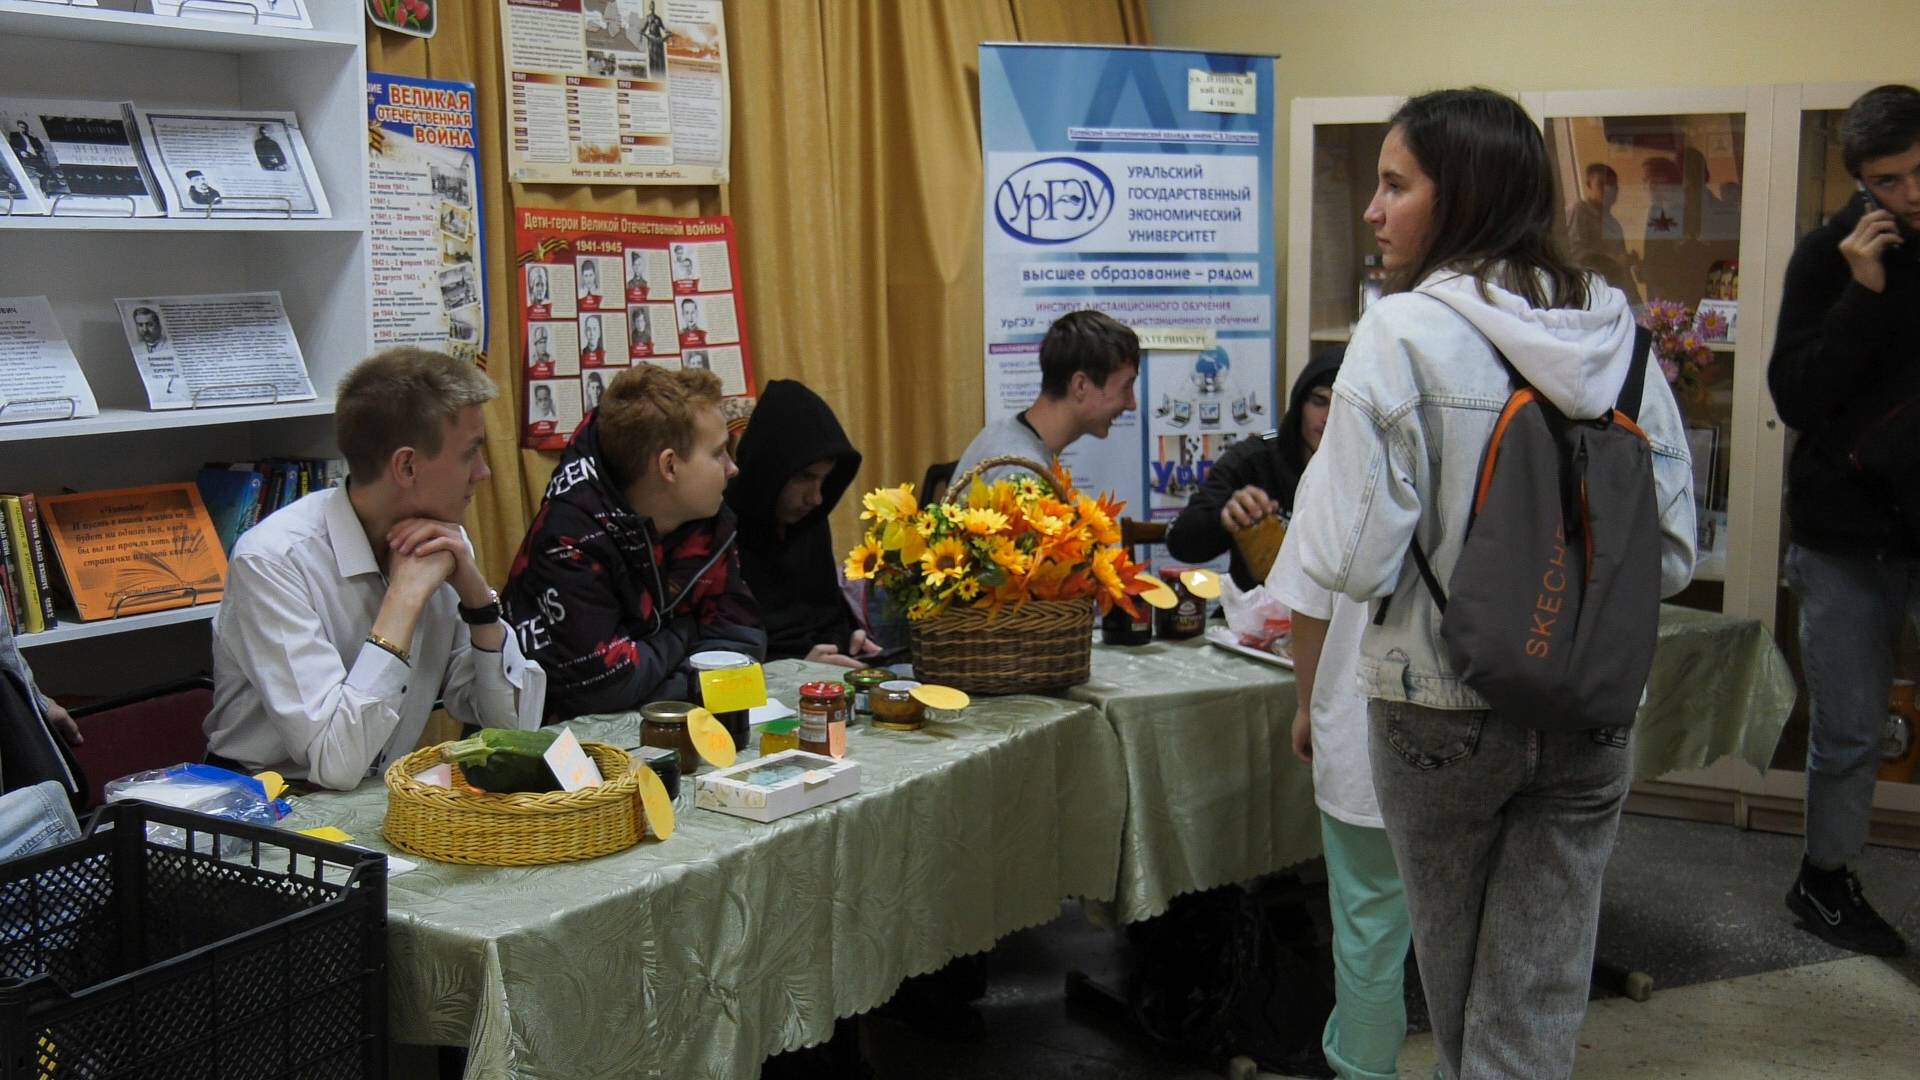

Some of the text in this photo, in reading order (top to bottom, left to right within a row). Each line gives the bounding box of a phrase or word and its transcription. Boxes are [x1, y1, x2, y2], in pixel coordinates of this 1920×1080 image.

[389, 84, 471, 111] ВЕЛИКАЯ
[376, 105, 472, 128] ОТЕЧЕСТВЕННАЯ
[414, 126, 474, 147] ВОЙНА
[1127, 165, 1203, 180] УРАЛЬСКИЙ
[1128, 185, 1250, 201] ГОСУДАРСТВЕННЫЙ
[1128, 207, 1241, 222] ЭКОНОМИЧЕСКИЙ
[524, 212, 725, 235] Дети-герои Великой Отечественной войны
[1128, 230, 1216, 243] УНИВЕРСИТЕТ
[576, 240, 623, 253] 1941-1945
[1023, 267, 1085, 281] высшее
[1091, 264, 1190, 282] образование
[1207, 268, 1253, 283] рядом
[1035, 301, 1232, 313] ИНСТИТУТ ДИСТАНЦИОННОГО ОБУЧЕНИЯ
[1000, 317, 1036, 330] УрГЭУ
[1128, 315, 1211, 328] дистанционного
[83, 555, 131, 569] странички
